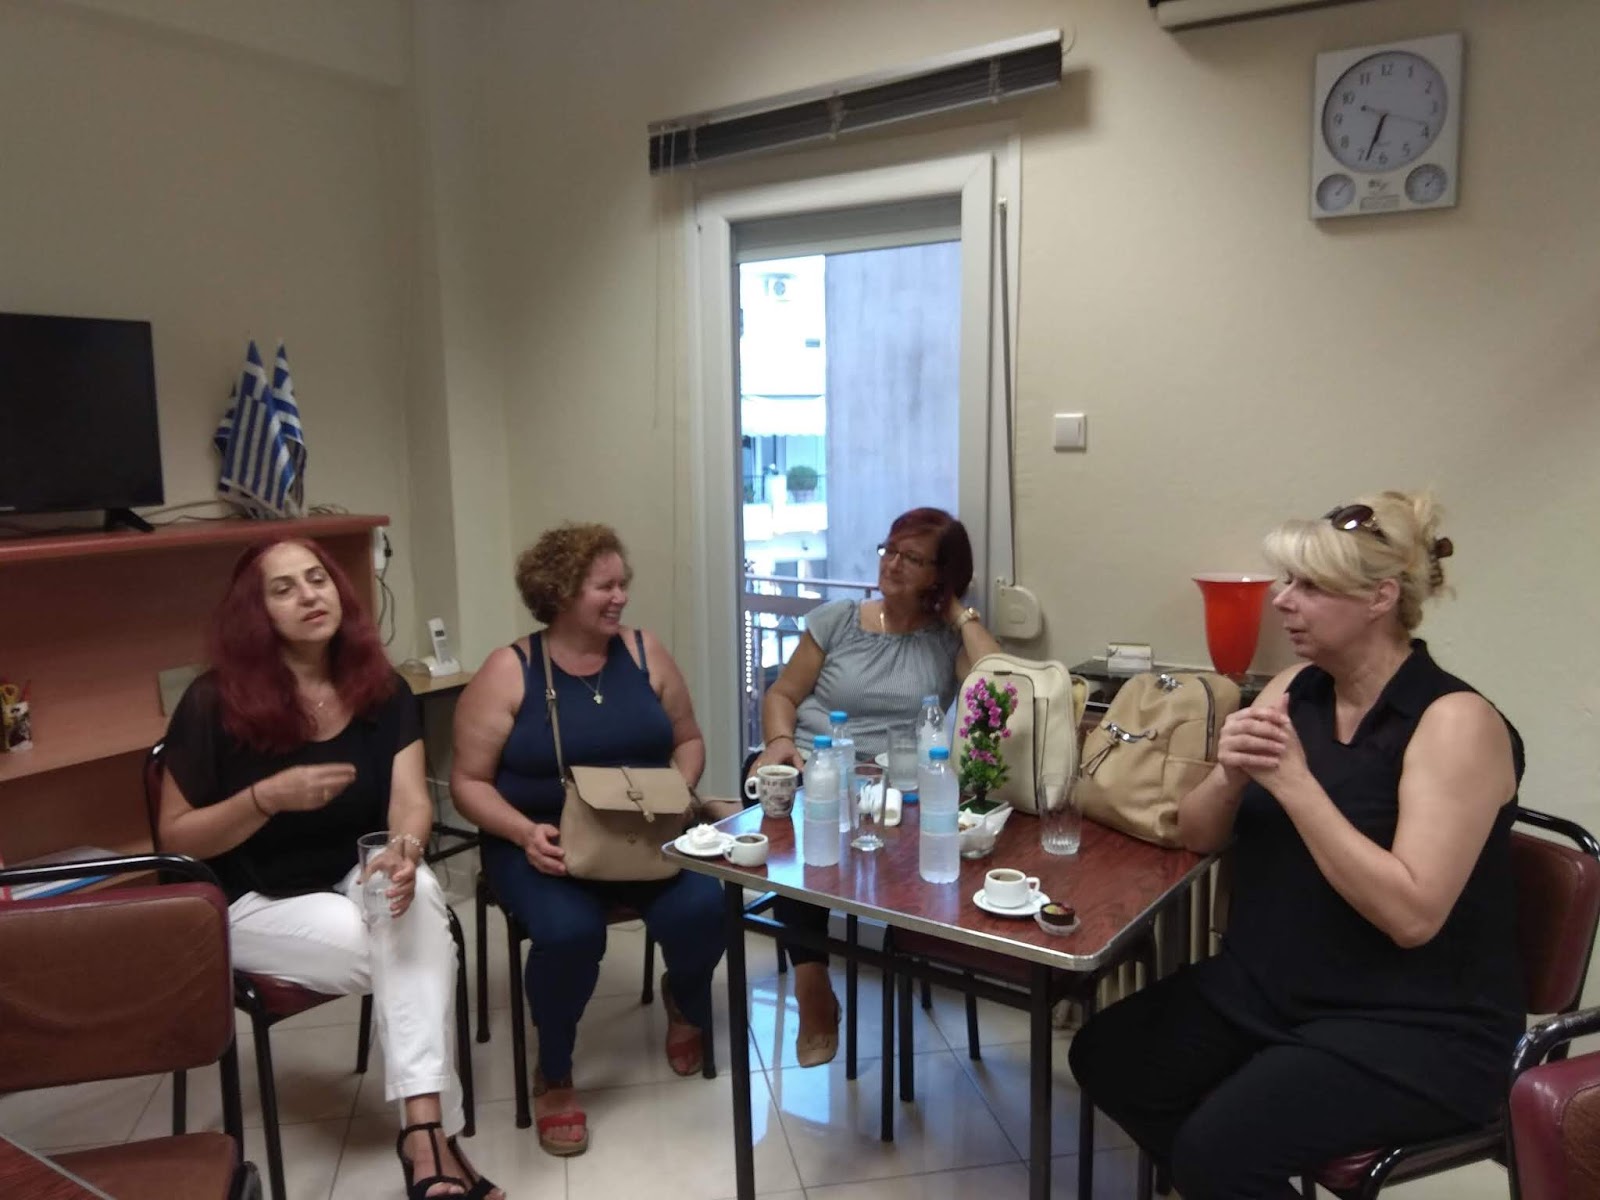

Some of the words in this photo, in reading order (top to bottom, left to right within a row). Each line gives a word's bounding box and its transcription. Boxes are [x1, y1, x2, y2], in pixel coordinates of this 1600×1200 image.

[1381, 63, 1394, 76] 12
[1360, 73, 1371, 85] 11
[1425, 80, 1432, 94] 2
[1342, 91, 1355, 104] 10
[1431, 101, 1438, 114] 3
[1334, 113, 1343, 125] 9
[1420, 124, 1429, 138] 4
[1341, 136, 1349, 148] 8
[1357, 149, 1365, 161] 7
[1402, 143, 1410, 157] 5
[1379, 152, 1388, 164] 6
